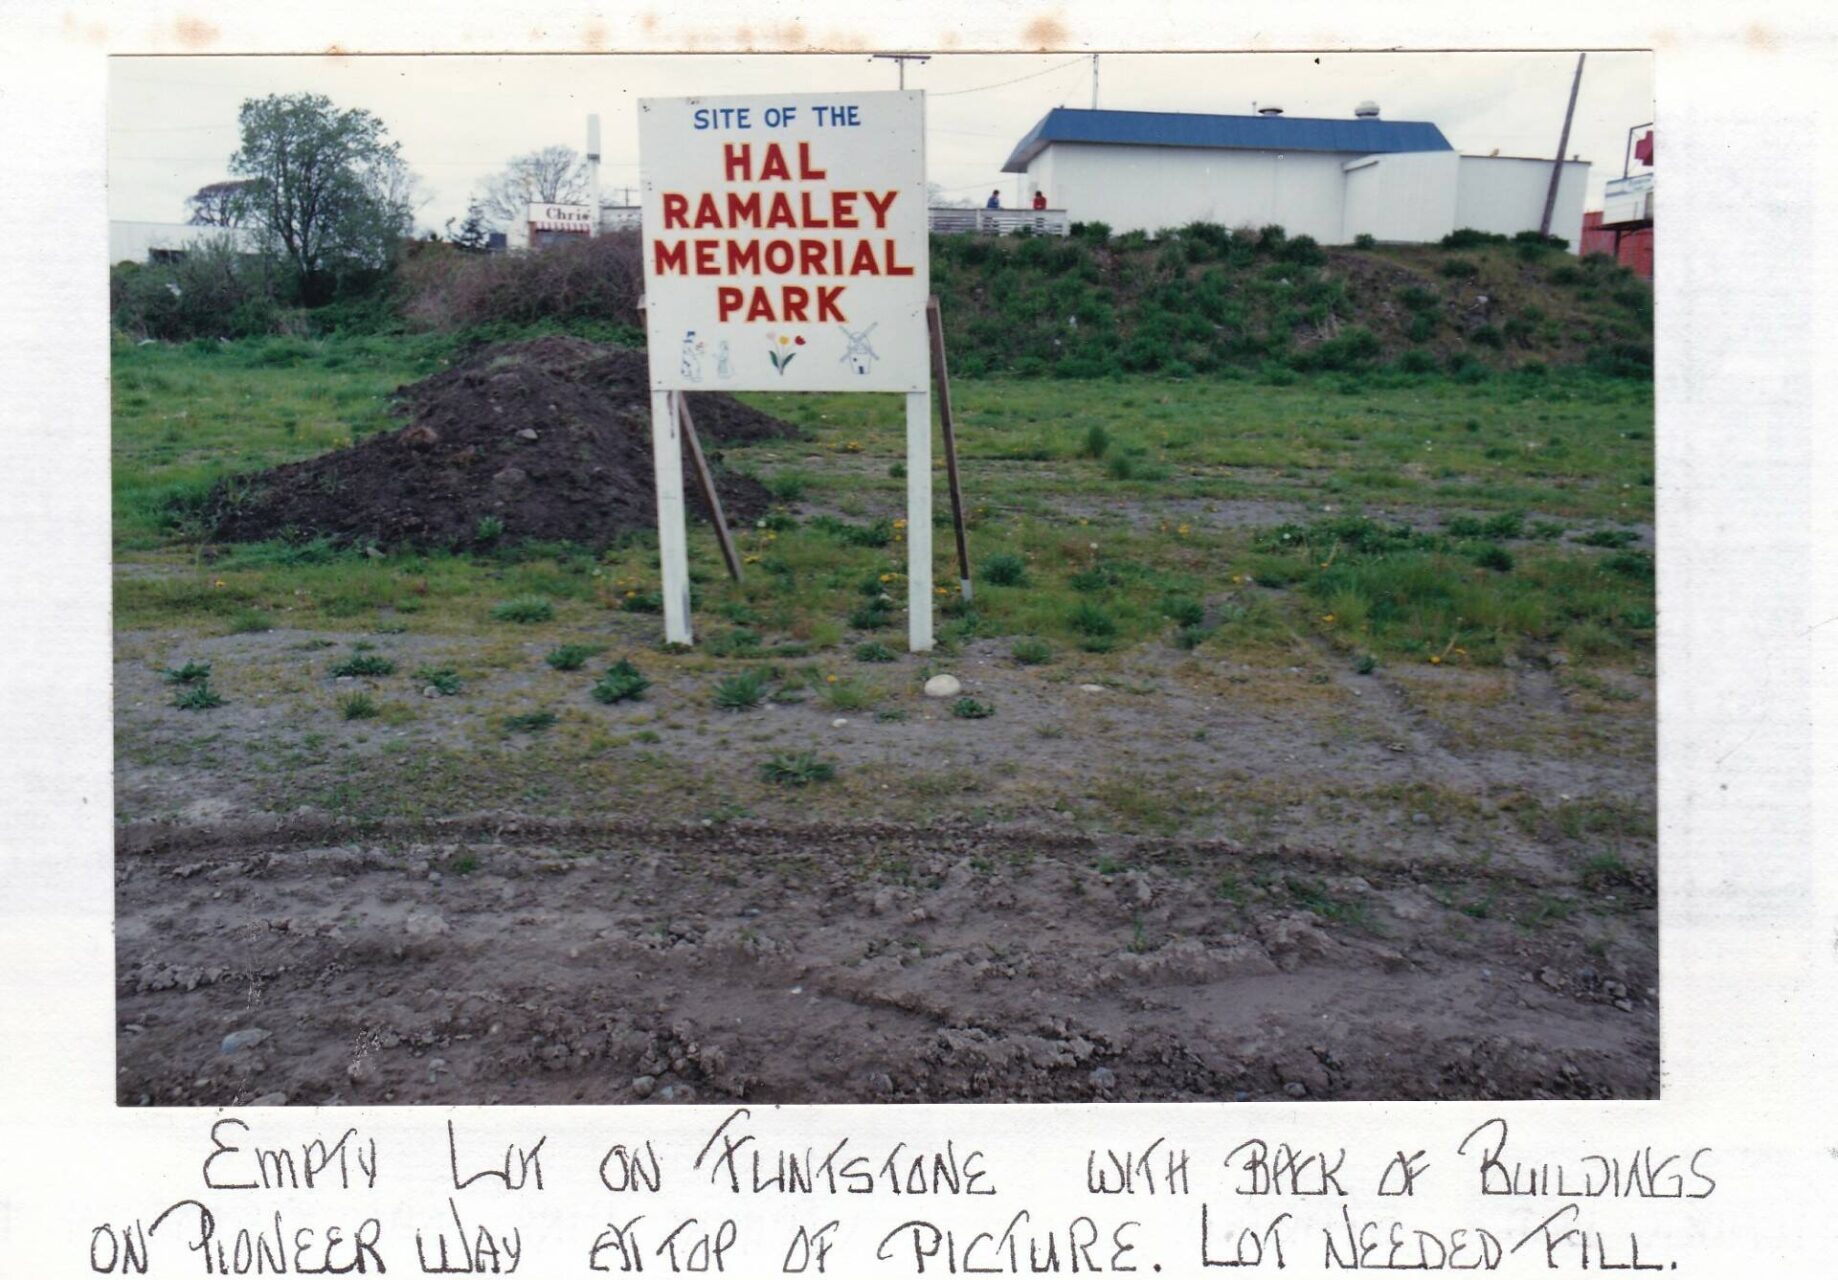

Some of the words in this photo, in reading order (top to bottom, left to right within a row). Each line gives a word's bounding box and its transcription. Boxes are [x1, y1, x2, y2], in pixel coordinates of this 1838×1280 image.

[694, 108, 751, 129] SITE
[764, 107, 797, 128] OF
[812, 106, 861, 126] THE
[723, 142, 827, 181] HAL
[662, 191, 897, 229] RAMALEY
[654, 239, 914, 276] MEMORIAL
[717, 286, 847, 323] PARK
[448, 1119, 547, 1190] LOT
[599, 1139, 661, 1192] ON
[694, 1108, 997, 1195] FLINTSTONE
[1088, 1136, 1189, 1195] WITH
[1224, 1138, 1348, 1196] BACK
[1378, 1149, 1430, 1196] OF
[1458, 1118, 1717, 1199] BUILDINGS
[90, 1218, 149, 1274] ON
[149, 1200, 387, 1275] PIONEER
[416, 1197, 521, 1274] WAY
[589, 1215, 646, 1272] AT
[656, 1218, 737, 1273] TOP
[782, 1219, 840, 1273] OF
[877, 1210, 1163, 1274] PICTURE.
[1201, 1203, 1293, 1269] LOT
[1322, 1204, 1503, 1271] NEEDED
[1510, 1203, 1678, 1271] FILL.
